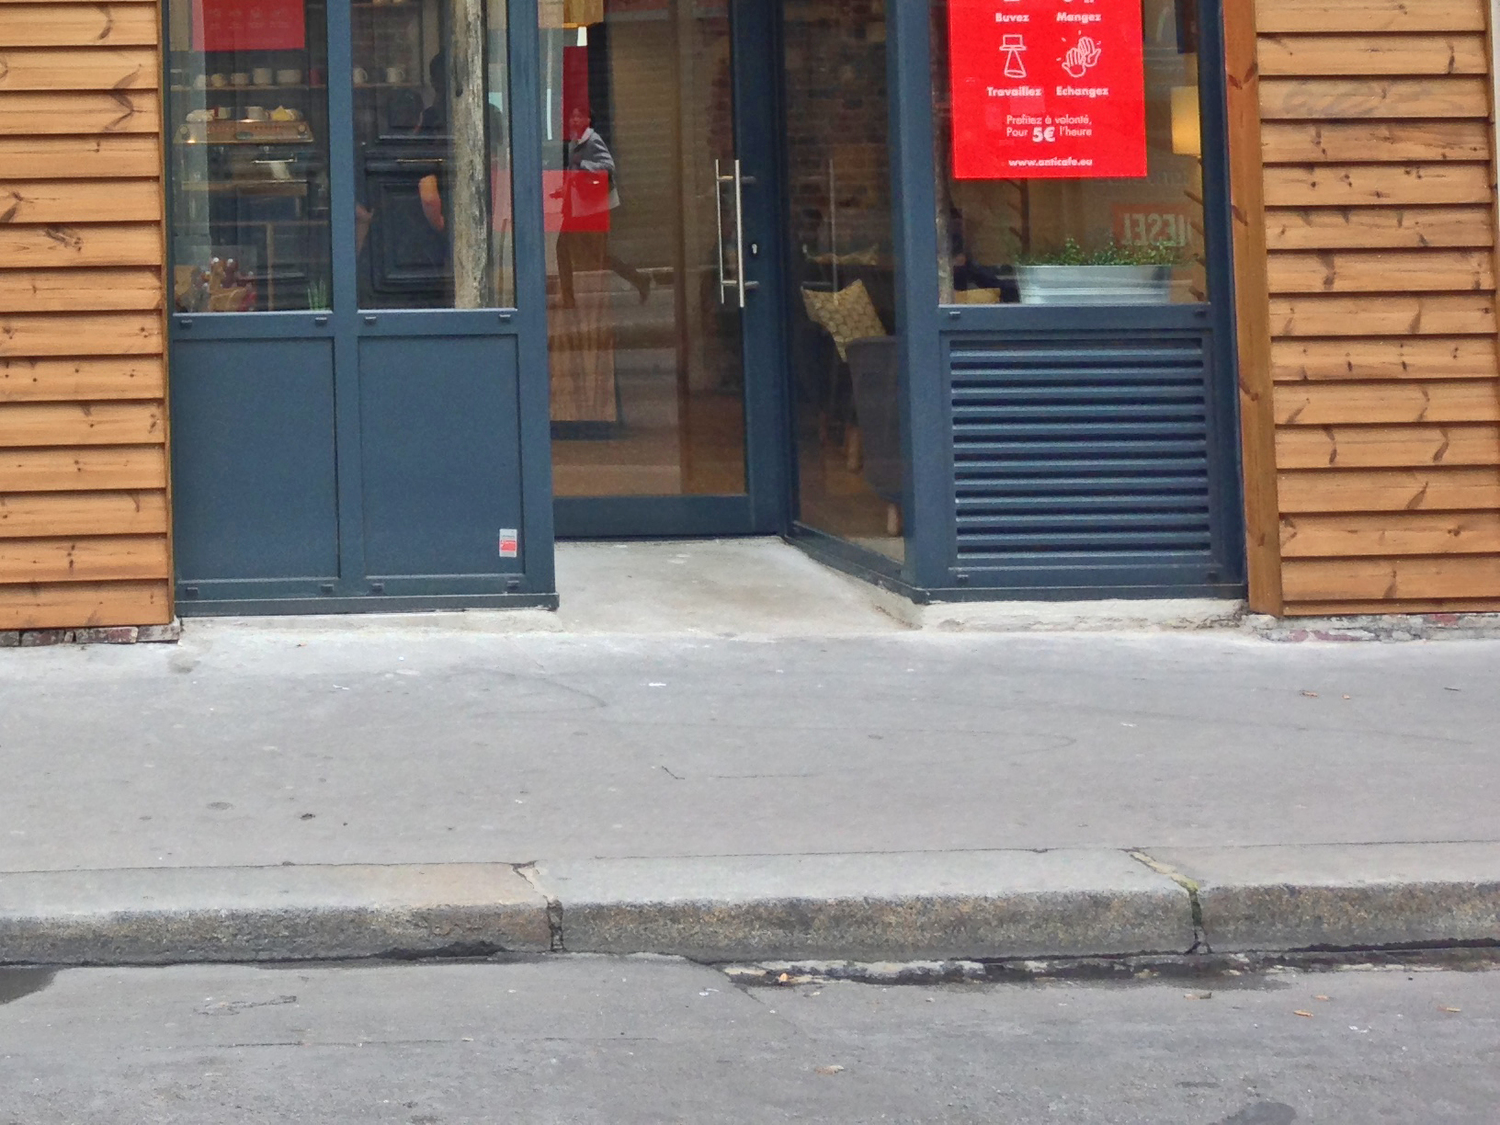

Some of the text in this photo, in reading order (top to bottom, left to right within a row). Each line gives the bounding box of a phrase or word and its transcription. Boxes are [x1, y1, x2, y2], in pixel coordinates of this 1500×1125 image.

[995, 12, 1030, 23] Buvez
[1056, 11, 1102, 24] Mangez
[986, 86, 1043, 97] Travaillez
[1056, 85, 1109, 98] Echangez
[1006, 114, 1043, 125] Profitez
[1044, 115, 1052, 125] à
[1006, 125, 1093, 143] Pour 5€ l'heure
[1008, 156, 1093, 167] www.anticafe.eu
